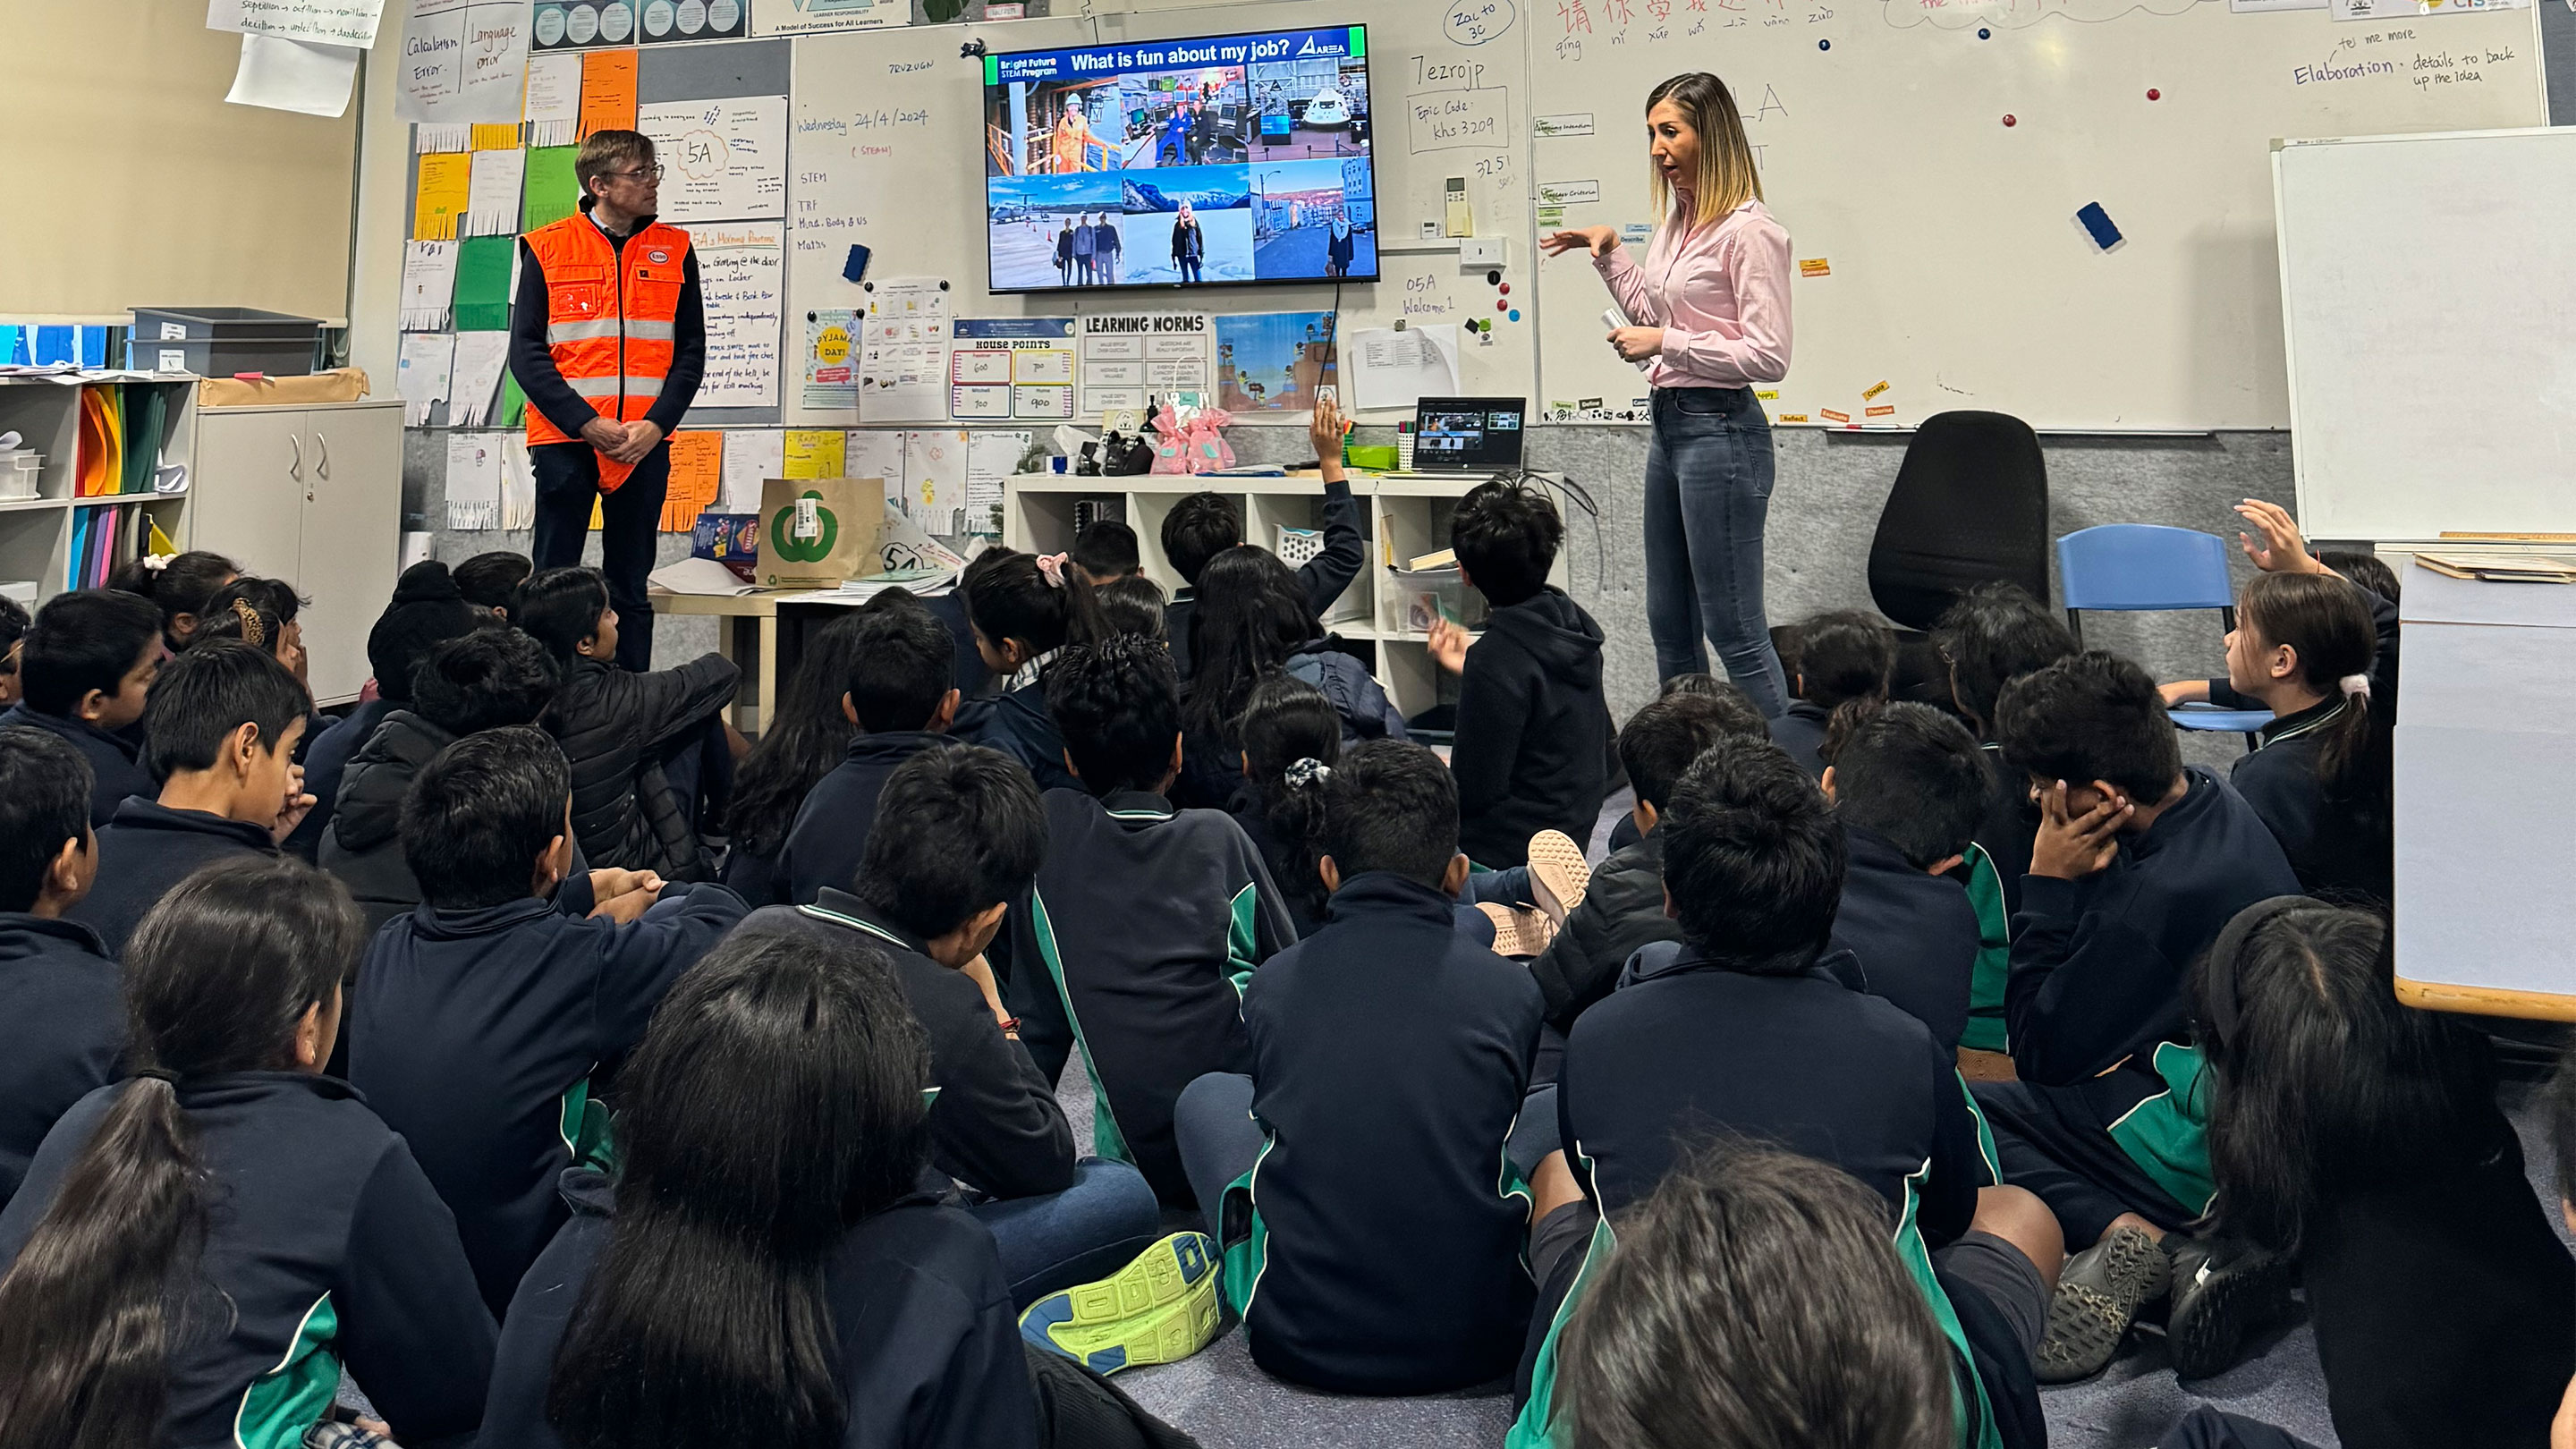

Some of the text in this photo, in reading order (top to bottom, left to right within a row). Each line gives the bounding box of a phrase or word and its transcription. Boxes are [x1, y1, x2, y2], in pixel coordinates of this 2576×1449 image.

[1453, 4, 1496, 26] Zac to
[781, 23, 800, 31] Model
[808, 21, 834, 30] Success
[835, 20, 844, 28] for
[855, 18, 884, 26] Learners
[470, 22, 517, 52] Language
[2365, 34, 2382, 44] me
[2388, 30, 2416, 41] more
[407, 36, 458, 55] Calculation
[1071, 38, 1290, 72] What is fun about my job?
[1000, 57, 1056, 70] Bright Future
[2294, 46, 2514, 85] Elaboration details to back
[1001, 67, 1057, 78] STEM Program
[2413, 75, 2429, 91] up
[2454, 70, 2482, 81] idea
[1415, 106, 1440, 123] Epic
[797, 119, 847, 136] Wednesday
[689, 140, 711, 164] 5A
[801, 173, 826, 183] STEM
[826, 217, 845, 227] Body
[798, 241, 826, 250] Maths
[741, 257, 748, 266] @
[750, 256, 759, 265] the
[762, 256, 780, 267] door
[1407, 275, 1436, 292] 05A
[1403, 297, 1445, 314] Welcome
[1086, 315, 1204, 333] LEARNING NORMS
[817, 334, 853, 343] PYJAMA
[974, 363, 988, 373] 600
[1868, 385, 1885, 396] Create
[1031, 398, 1050, 409] 900
